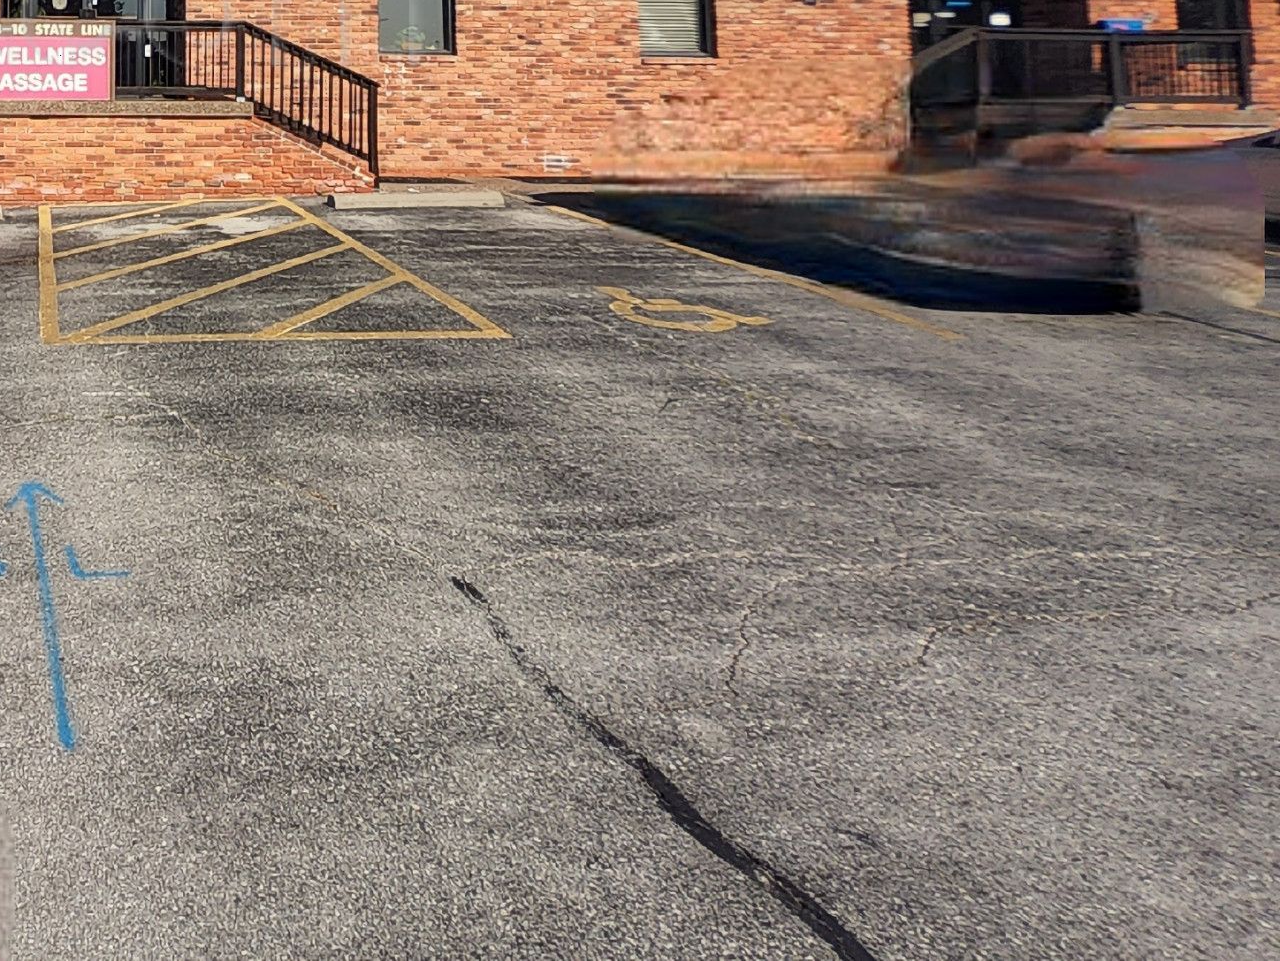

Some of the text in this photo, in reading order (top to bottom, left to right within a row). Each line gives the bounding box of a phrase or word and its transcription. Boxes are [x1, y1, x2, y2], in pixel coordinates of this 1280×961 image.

[34, 23, 74, 36] STATE
[80, 23, 112, 36] LINE
[63, 543, 132, 579] L
